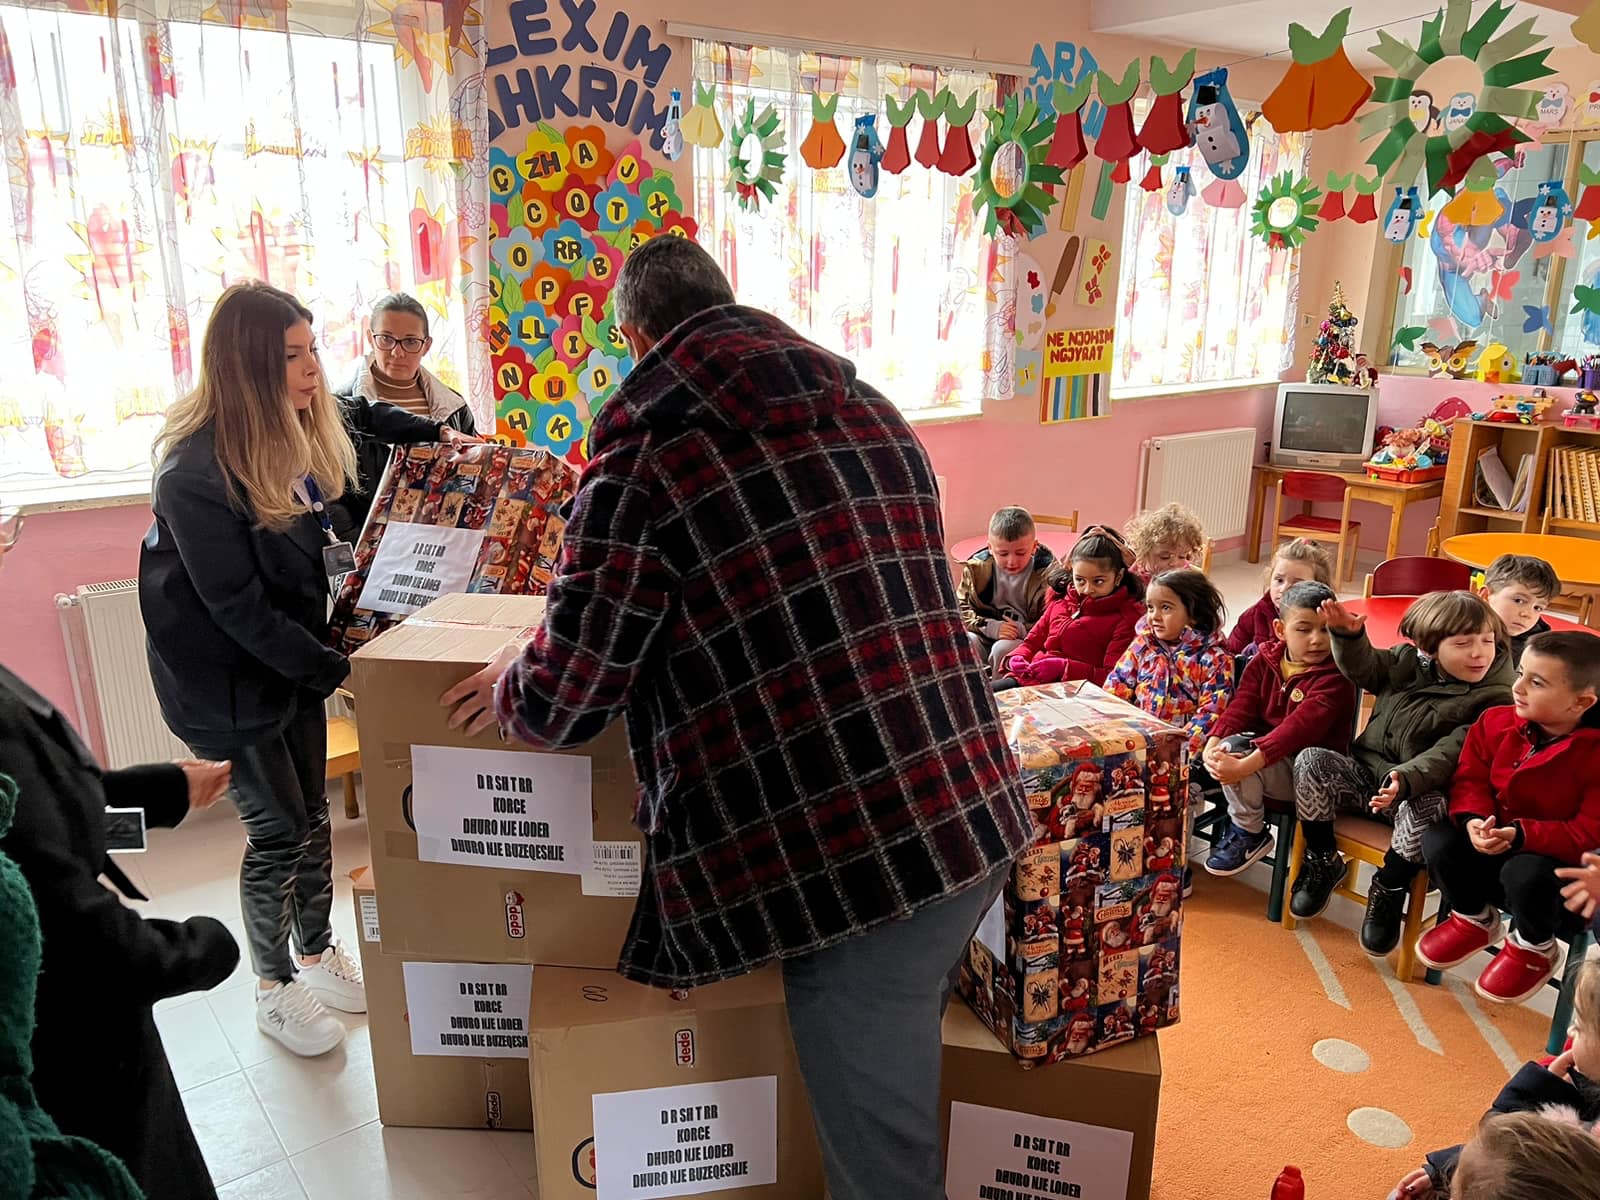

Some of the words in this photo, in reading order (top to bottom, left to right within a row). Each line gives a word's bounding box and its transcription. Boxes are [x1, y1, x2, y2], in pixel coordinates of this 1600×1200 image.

[578, 143, 593, 165] A
[524, 157, 562, 180] ZH
[620, 163, 635, 178] J
[527, 203, 542, 223] C
[571, 193, 585, 213] Q
[611, 202, 624, 221] T
[649, 194, 667, 216] X
[513, 247, 527, 267] O
[553, 240, 583, 260] RR
[593, 256, 608, 277] B
[541, 281, 554, 300] P
[575, 297, 589, 316] F
[517, 319, 549, 339] LL
[1047, 332, 1064, 348] NE
[1069, 329, 1114, 347] NJOHIM
[569, 336, 579, 354] I
[1050, 345, 1104, 363] NGJYRAT
[502, 366, 520, 388] N
[593, 369, 607, 388] D
[547, 380, 563, 398] U
[508, 412, 528, 431] H
[550, 417, 569, 438] K
[477, 774, 483, 789] D
[487, 775, 493, 790] R
[495, 776, 509, 792] SH
[511, 777, 517, 792] T
[519, 777, 533, 793] RR
[493, 797, 526, 814] KORCE
[463, 818, 498, 835] DHURO
[500, 820, 517, 837] NJE
[519, 821, 550, 838] LODER
[451, 838, 485, 855] DHURO
[486, 841, 503, 856] NJE
[509, 907, 522, 935] dede
[679, 1032, 691, 1063] dede
[661, 1110, 669, 1125] D
[671, 1109, 678, 1124] R
[680, 1107, 694, 1123] SH
[696, 1106, 702, 1121] T
[704, 1104, 718, 1120] RR
[677, 1126, 710, 1143] KORCE
[647, 1149, 682, 1167] DHURO
[684, 1146, 701, 1163] NJE
[703, 1143, 734, 1161] LODER
[1014, 1133, 1022, 1148] D
[1023, 1135, 1031, 1149] R
[1032, 1137, 1046, 1153] SH
[1048, 1139, 1055, 1154] T
[1056, 1141, 1071, 1157] RR
[1027, 1155, 1061, 1175] KORCE
[632, 1171, 668, 1189] DHURO
[670, 1168, 687, 1185] NJE
[995, 1168, 1030, 1188] DHURO
[1031, 1176, 1049, 1192] NJE
[1050, 1178, 1081, 1198] LODER
